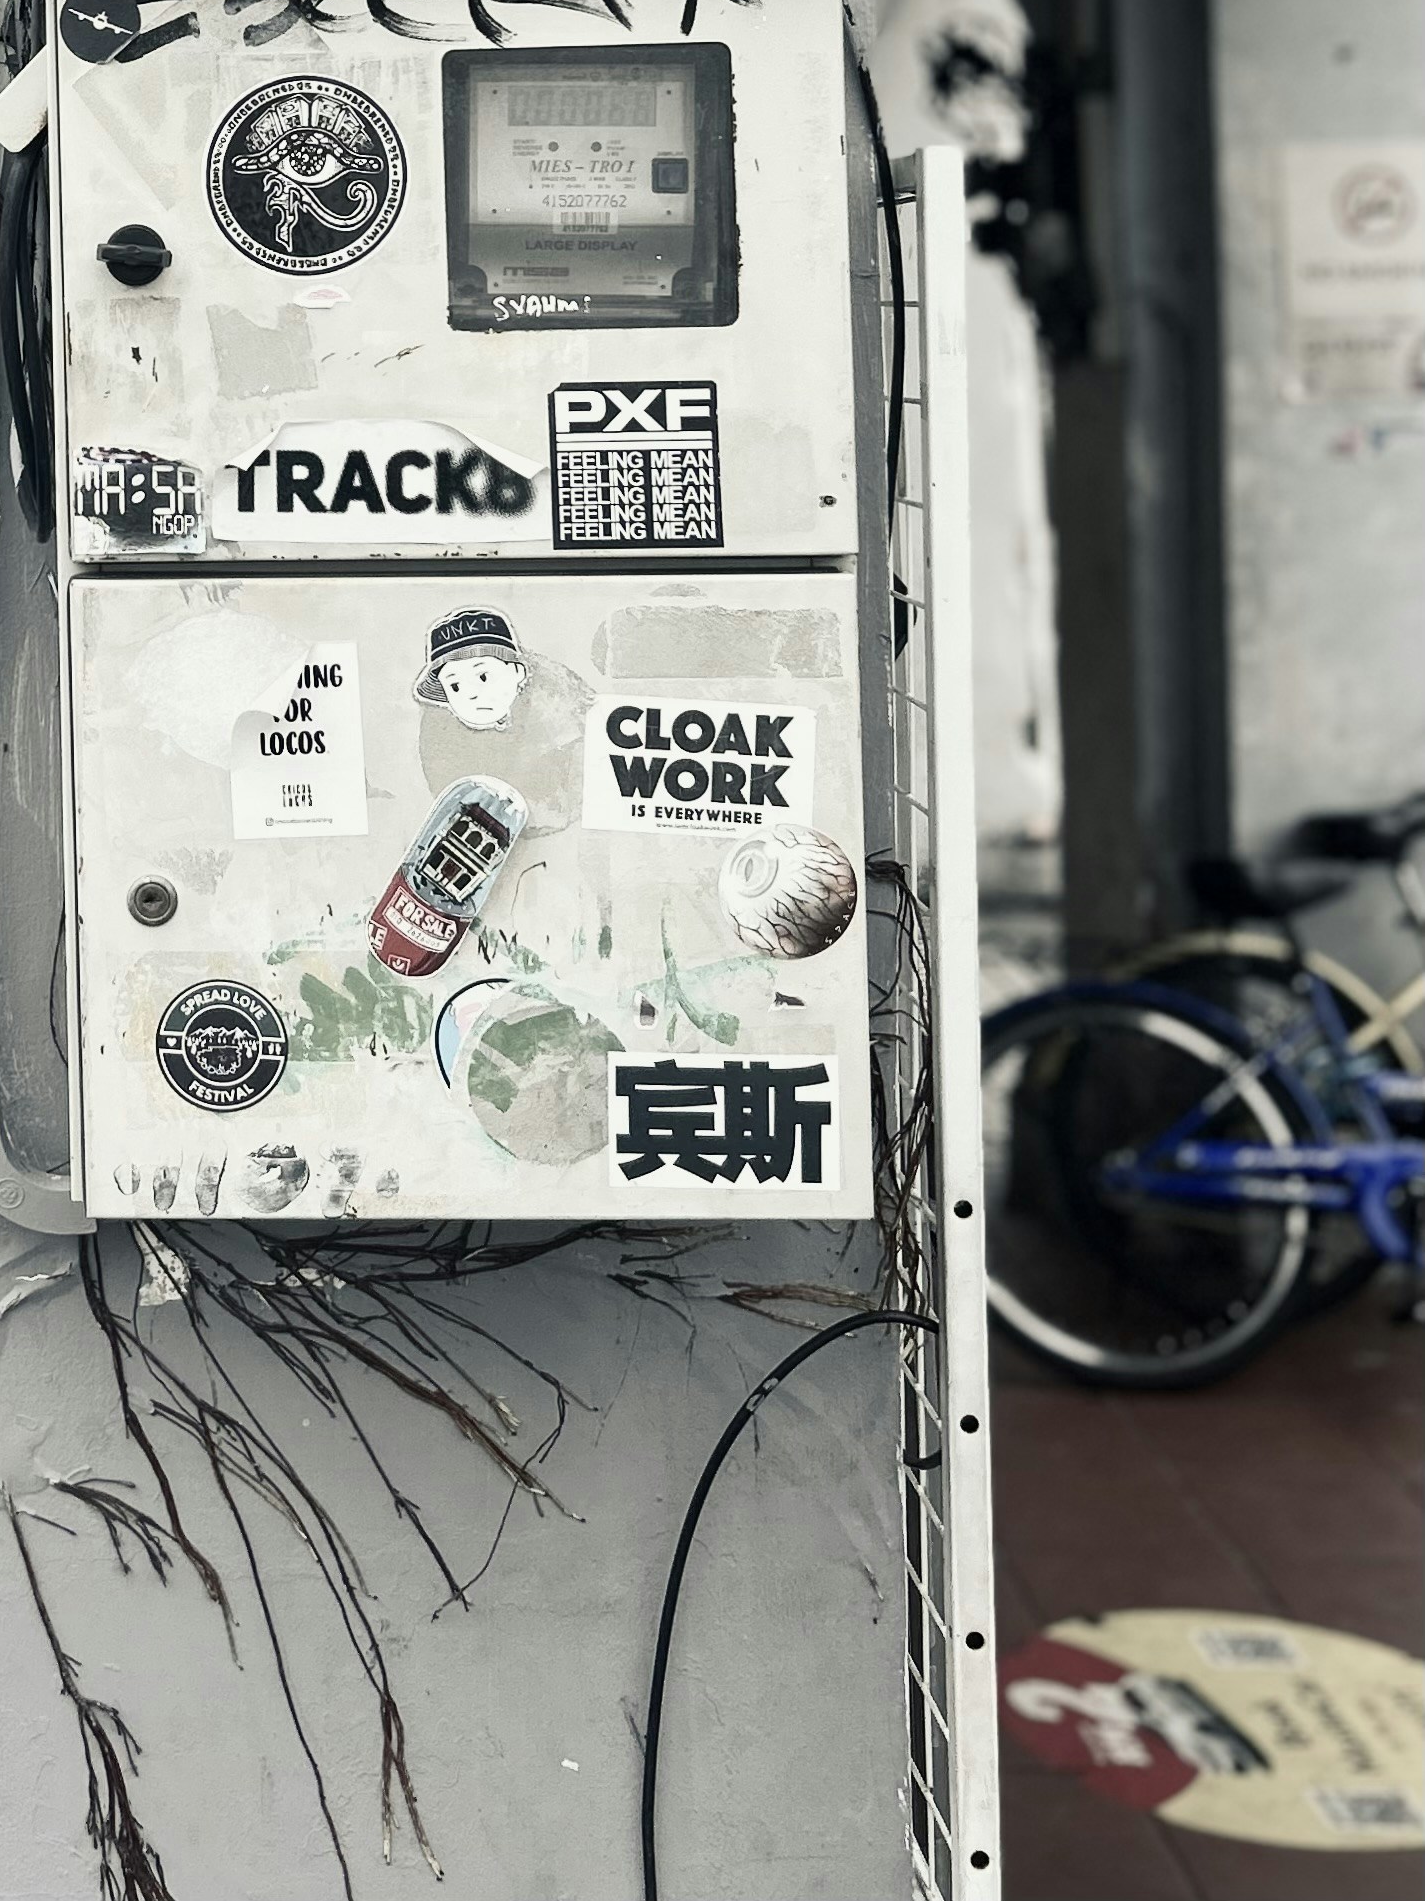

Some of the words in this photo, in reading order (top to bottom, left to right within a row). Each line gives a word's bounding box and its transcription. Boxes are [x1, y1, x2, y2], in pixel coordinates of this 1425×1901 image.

[542, 194, 627, 208] 4152077762
[525, 240, 574, 251] LARGE
[578, 240, 638, 251] DISPLAY
[554, 388, 711, 432] PXF
[557, 451, 644, 469] FEELING
[650, 450, 713, 468] MEAN
[557, 469, 644, 487] FEELING
[650, 468, 713, 486] MEAN
[558, 487, 645, 505] FEELING
[651, 486, 714, 504] MEAN
[559, 505, 646, 522] FEELING
[652, 503, 715, 521] MEAN
[560, 523, 647, 540] FEELING
[653, 521, 716, 539] MEAN
[606, 705, 794, 758] CLOAK
[260, 730, 326, 756] LOCOS
[609, 754, 790, 808] WORK
[631, 804, 645, 817] IS
[655, 806, 762, 824] EVERYWHERE
[394, 894, 424, 925] FOR
[421, 914, 456, 938] SALE
[180, 989, 231, 1016] SPREAD
[233, 991, 267, 1020] LOVE
[188, 1080, 254, 1102] FESTIVAL
